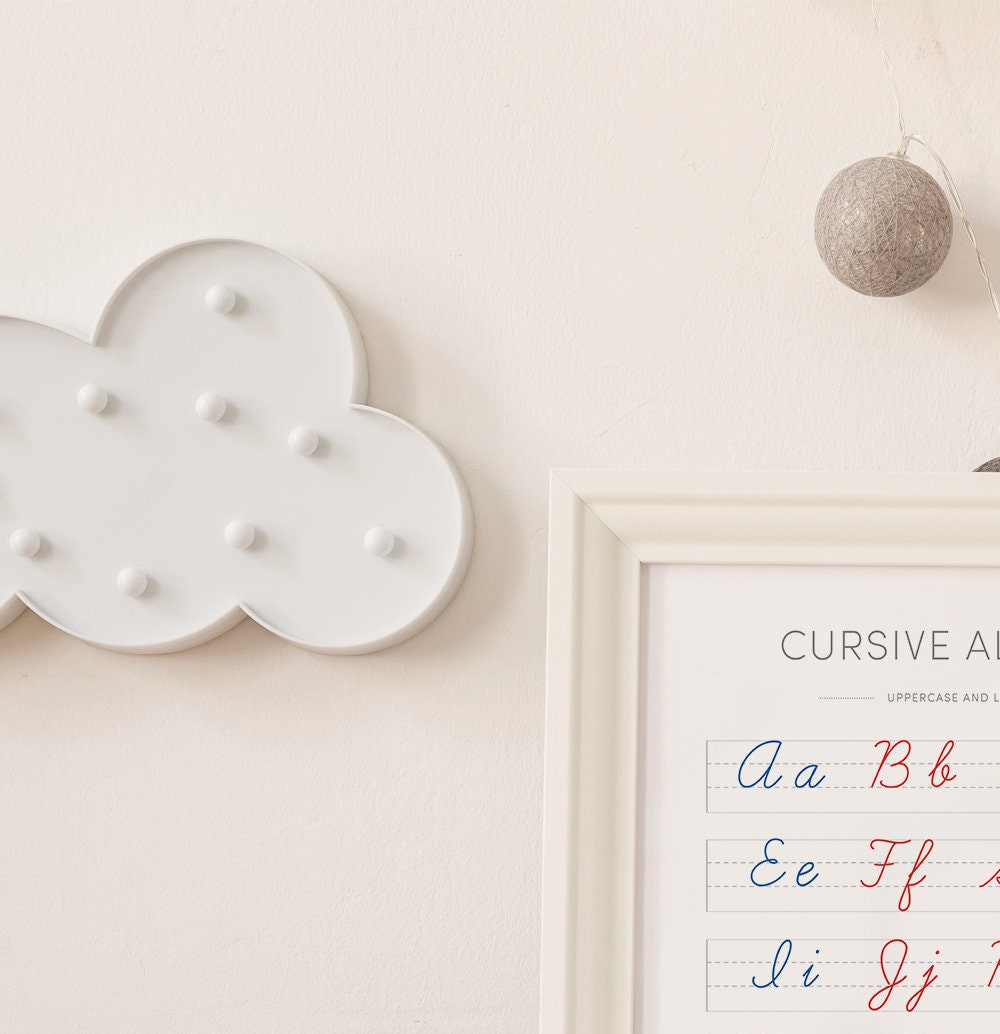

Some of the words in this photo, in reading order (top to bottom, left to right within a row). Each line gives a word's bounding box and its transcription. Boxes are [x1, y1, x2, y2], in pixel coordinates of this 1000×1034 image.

[781, 629, 950, 661] CURSIVE
[887, 692, 958, 703] UPPERCASE
[962, 692, 989, 703] AND
